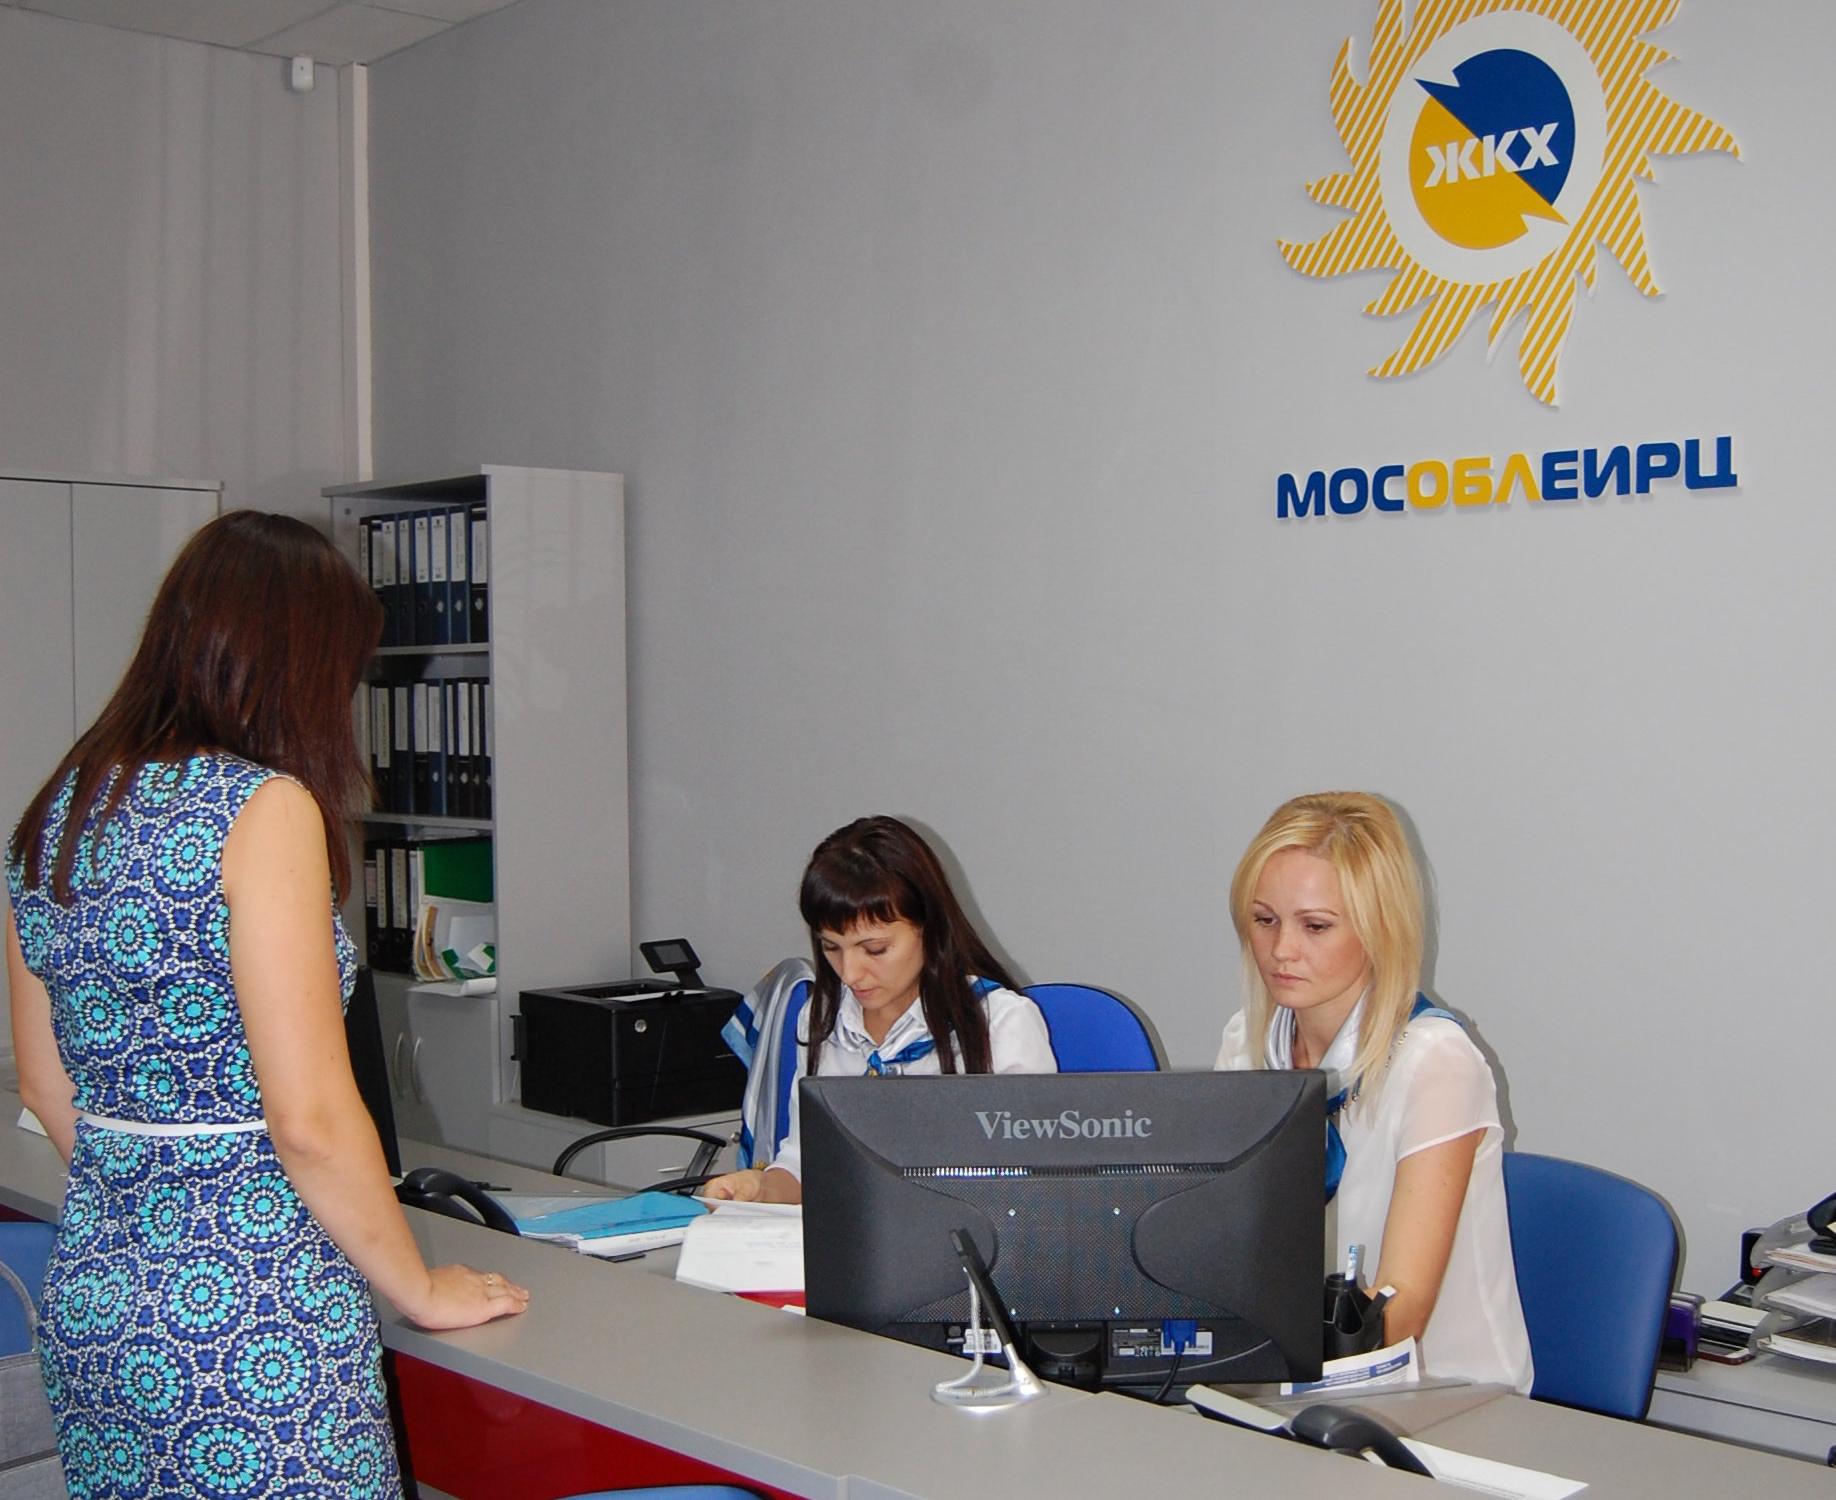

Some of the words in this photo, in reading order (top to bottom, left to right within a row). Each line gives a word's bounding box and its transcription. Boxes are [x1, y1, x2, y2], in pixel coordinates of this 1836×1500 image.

[1424, 122, 1559, 188] ЖКХ
[1276, 436, 1738, 519] МОСОБЛЕИРЦ
[974, 1109, 1153, 1140] ViewSonic
